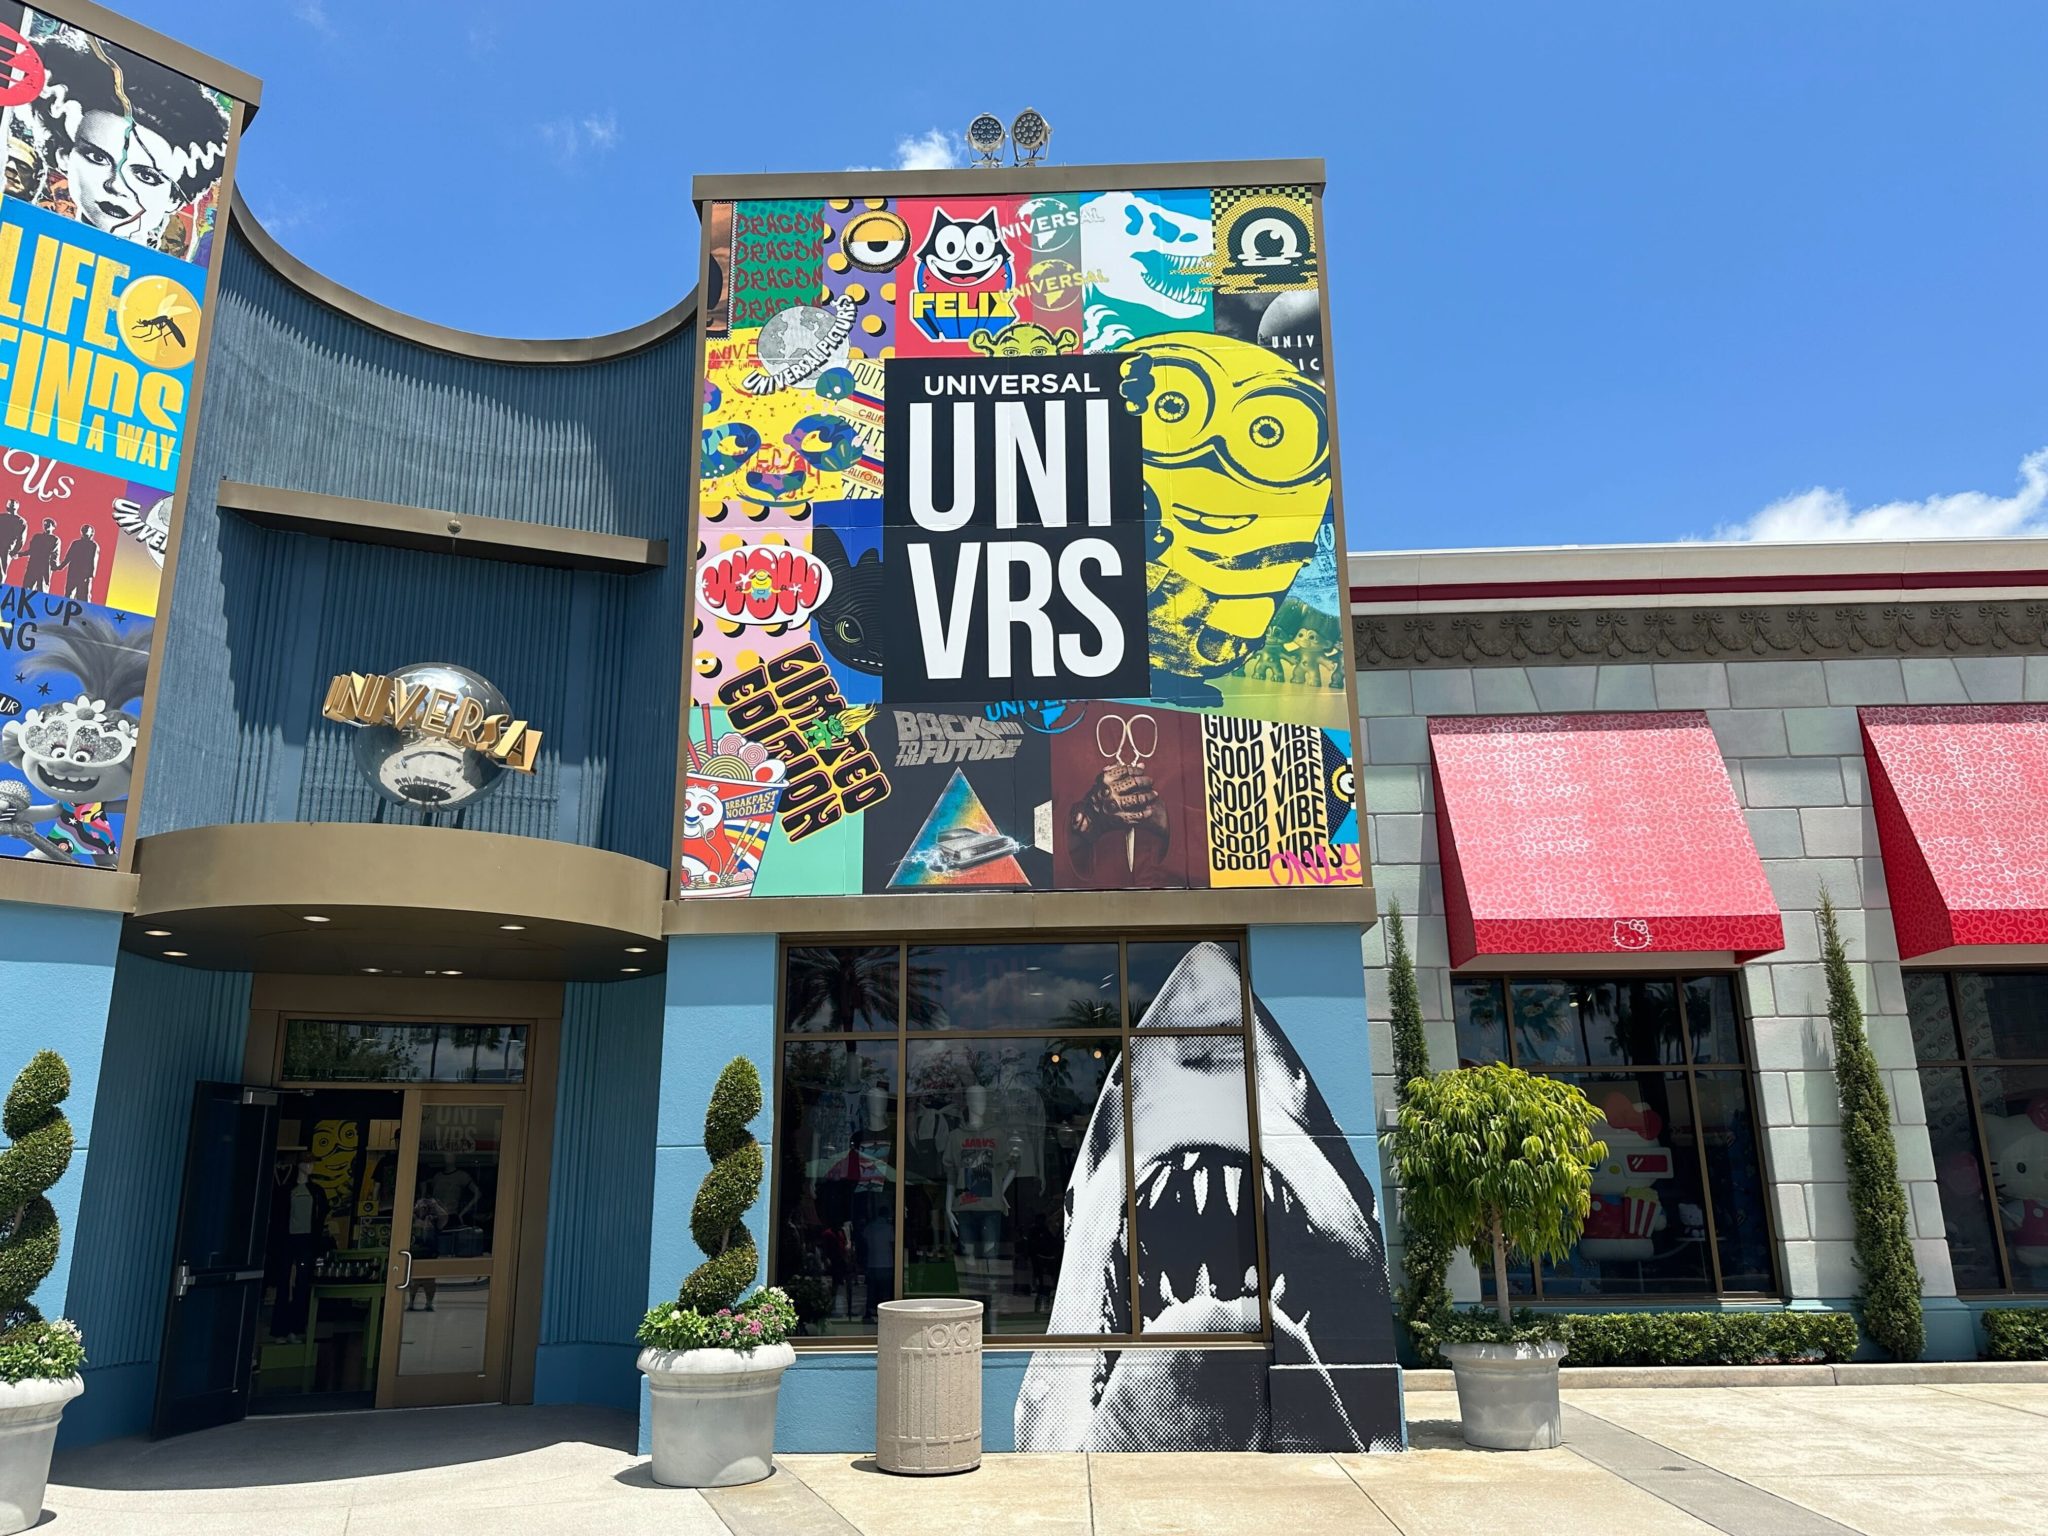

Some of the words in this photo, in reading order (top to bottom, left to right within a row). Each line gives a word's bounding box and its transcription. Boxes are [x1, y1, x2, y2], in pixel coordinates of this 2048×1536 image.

[0, 221, 131, 351] LIFE
[913, 291, 1016, 328] FELIX
[742, 346, 823, 396] UNIVERSAL
[817, 294, 858, 360] PICTURES
[924, 372, 1101, 396] UNIVERSAL
[86, 414, 105, 453] A
[116, 421, 176, 471] WAY
[908, 398, 1112, 532] UNI
[3, 447, 75, 502] Us
[112, 497, 168, 554] UNIVE
[702, 547, 823, 620] WOW
[907, 537, 1125, 680] VRS
[718, 664, 843, 843] EDITION
[767, 642, 890, 814] LIMTED
[893, 710, 1024, 740] BACK
[898, 740, 919, 755] TO
[918, 739, 1022, 765] FUTURE
[894, 754, 920, 767] THE
[1206, 738, 1264, 779] GOOD
[1207, 766, 1266, 812] GOOD
[1271, 739, 1321, 780] VIBE
[725, 790, 780, 810] BREAKFAST
[726, 801, 775, 819] NOODLES
[1209, 794, 1268, 835] GOOD
[1273, 761, 1323, 808] VIBE
[1210, 820, 1269, 854] GOOD
[1275, 794, 1326, 837] VIBE
[1212, 847, 1271, 871] GOOD
